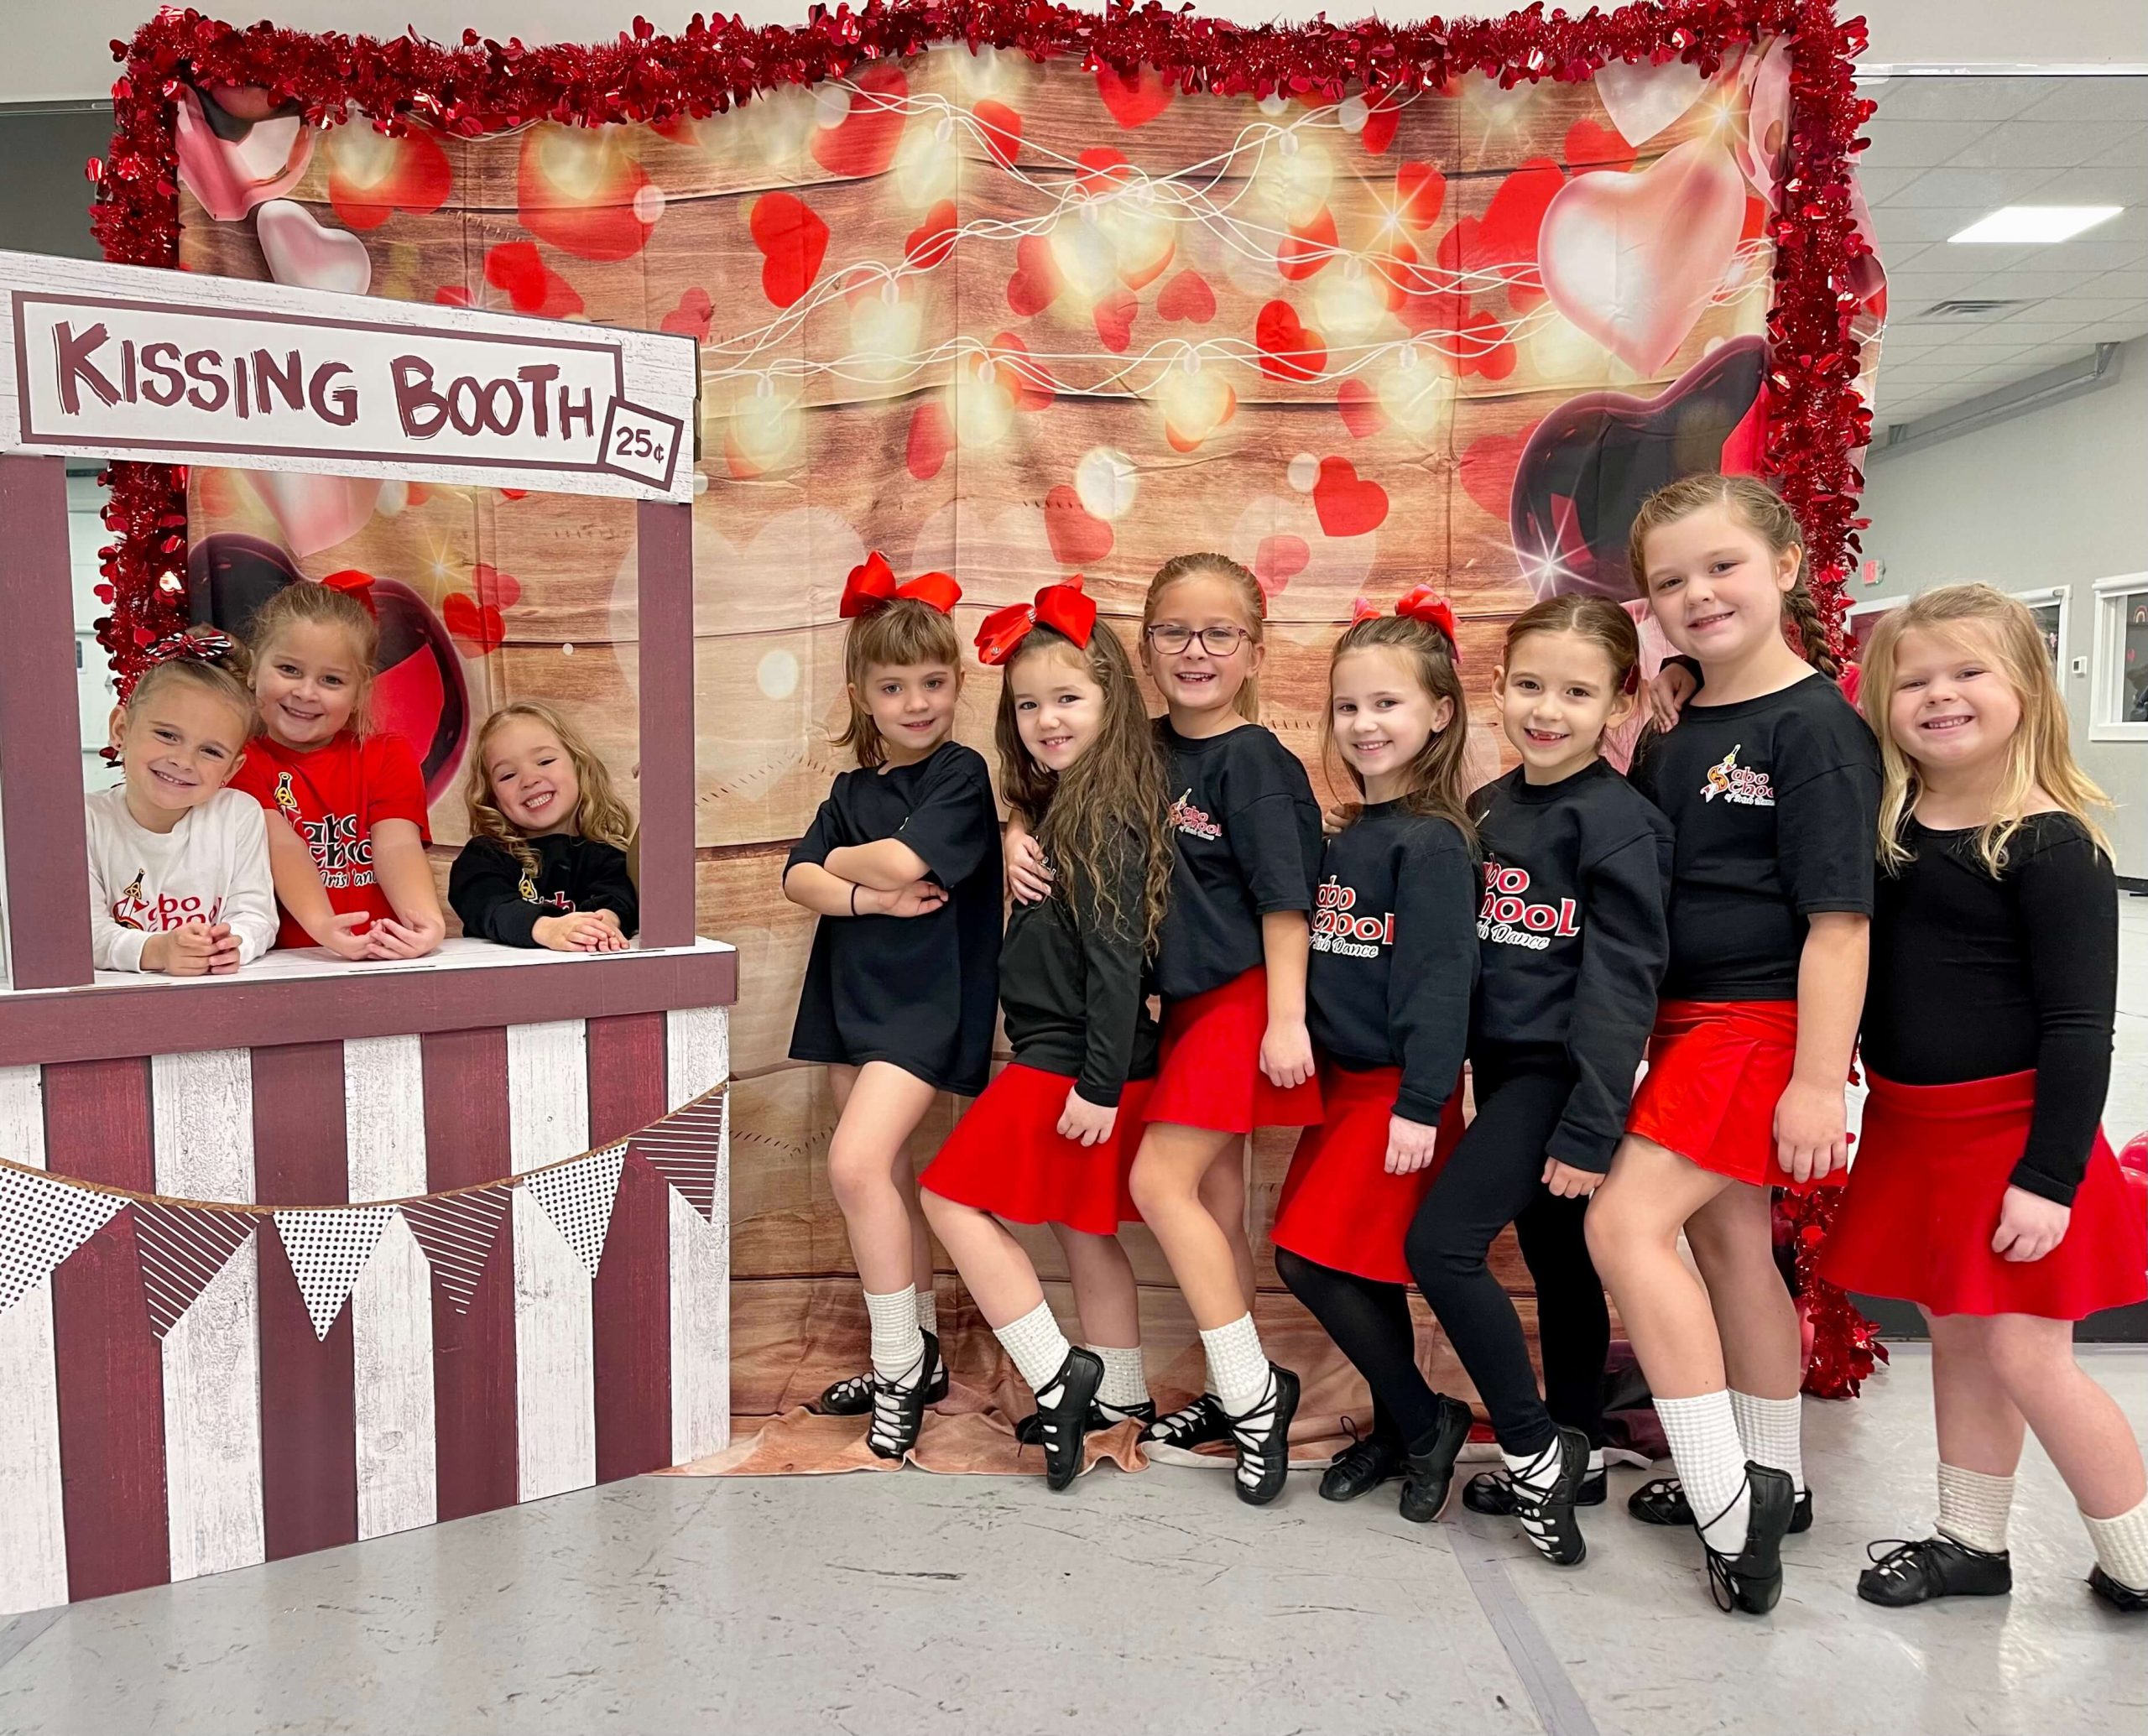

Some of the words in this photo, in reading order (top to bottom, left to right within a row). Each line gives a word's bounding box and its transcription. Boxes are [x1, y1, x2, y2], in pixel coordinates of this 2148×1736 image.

[52, 320, 358, 426] KISSING
[390, 354, 595, 441] BOOTH
[616, 426, 665, 464] 25¢
[1332, 937, 1379, 958] Dance
[1491, 923, 1551, 950] Dance
